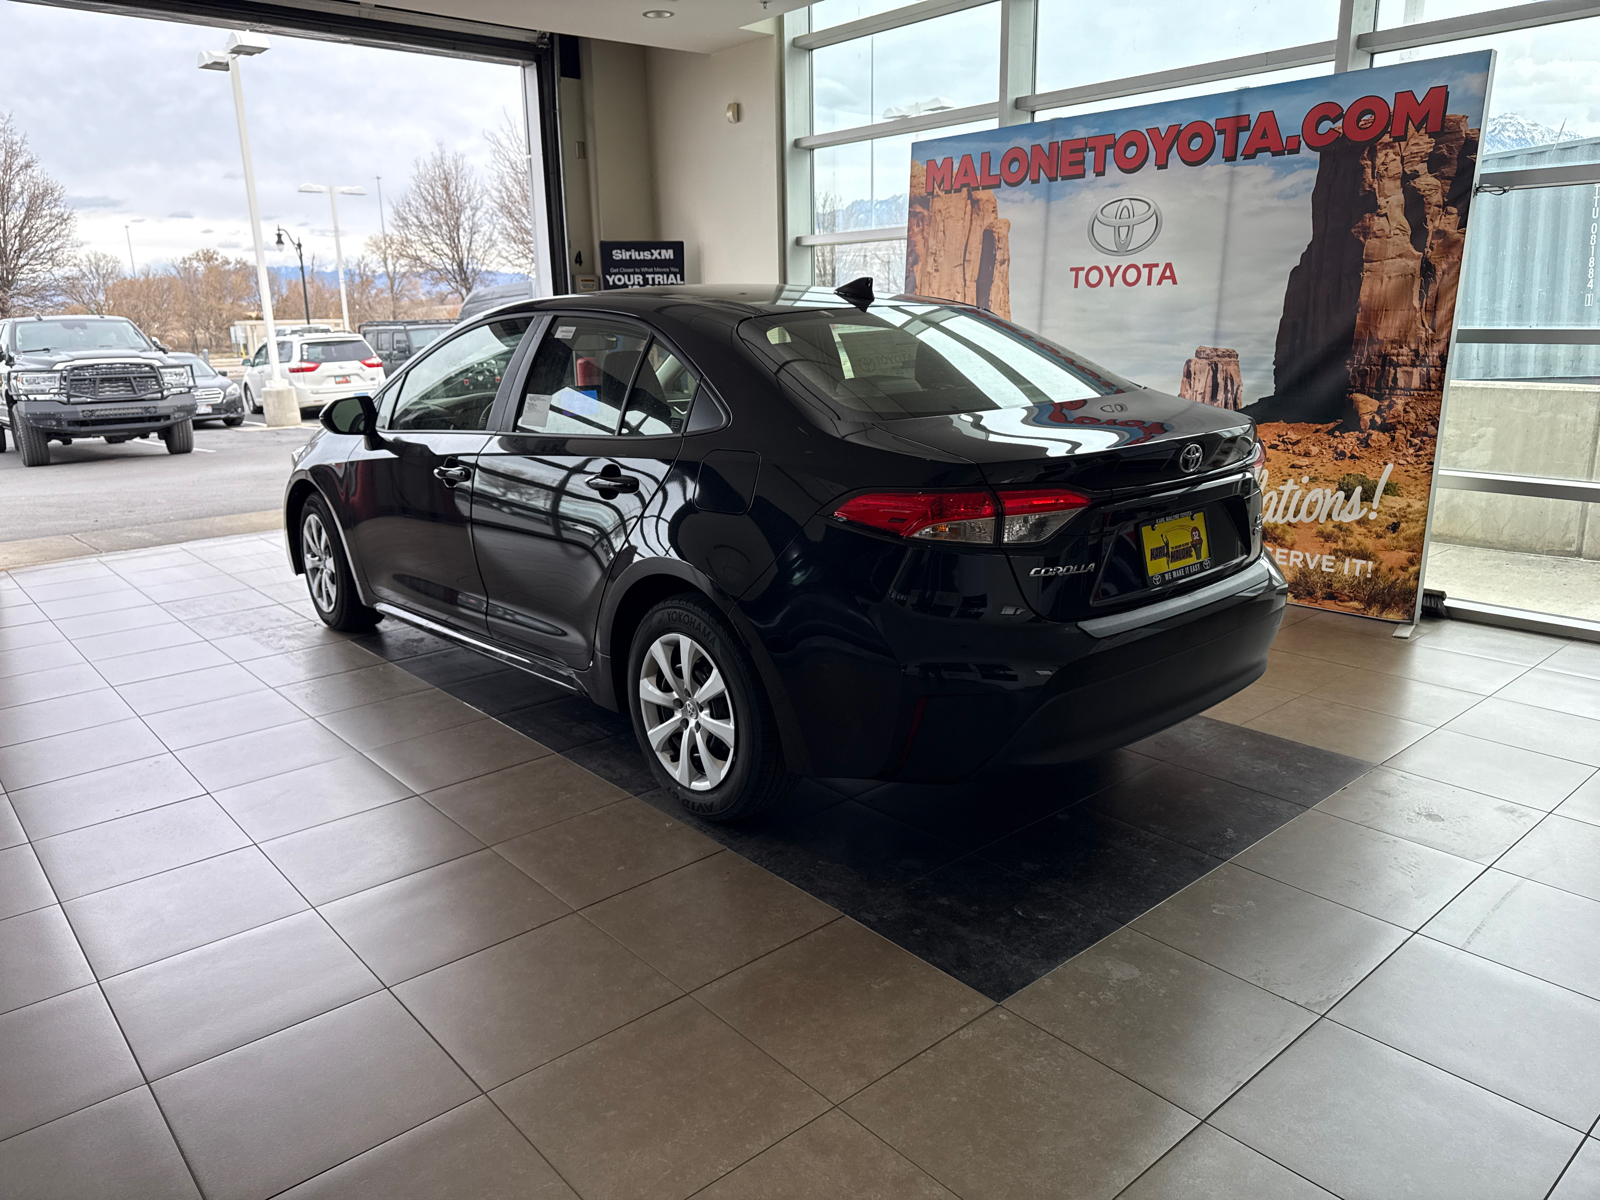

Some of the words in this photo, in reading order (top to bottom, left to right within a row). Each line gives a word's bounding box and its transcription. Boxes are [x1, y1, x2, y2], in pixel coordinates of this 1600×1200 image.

[925, 85, 1449, 195] MALONETOYOTA.COM
[575, 251, 583, 266] 4
[612, 249, 674, 260] SiriusXM
[1587, 223, 1598, 290] 081884
[606, 274, 644, 285] YOUR
[646, 274, 684, 285] TRIAL
[1069, 262, 1178, 289] TOYOTA
[1029, 562, 1096, 577] COROLLA
[1164, 572, 1172, 580] WE
[1173, 568, 1184, 578] MAKE
[1190, 564, 1200, 573] EASY
[1343, 557, 1374, 579] IT!
[666, 611, 717, 649] YOKOHAMA
[682, 798, 714, 813] AVID
